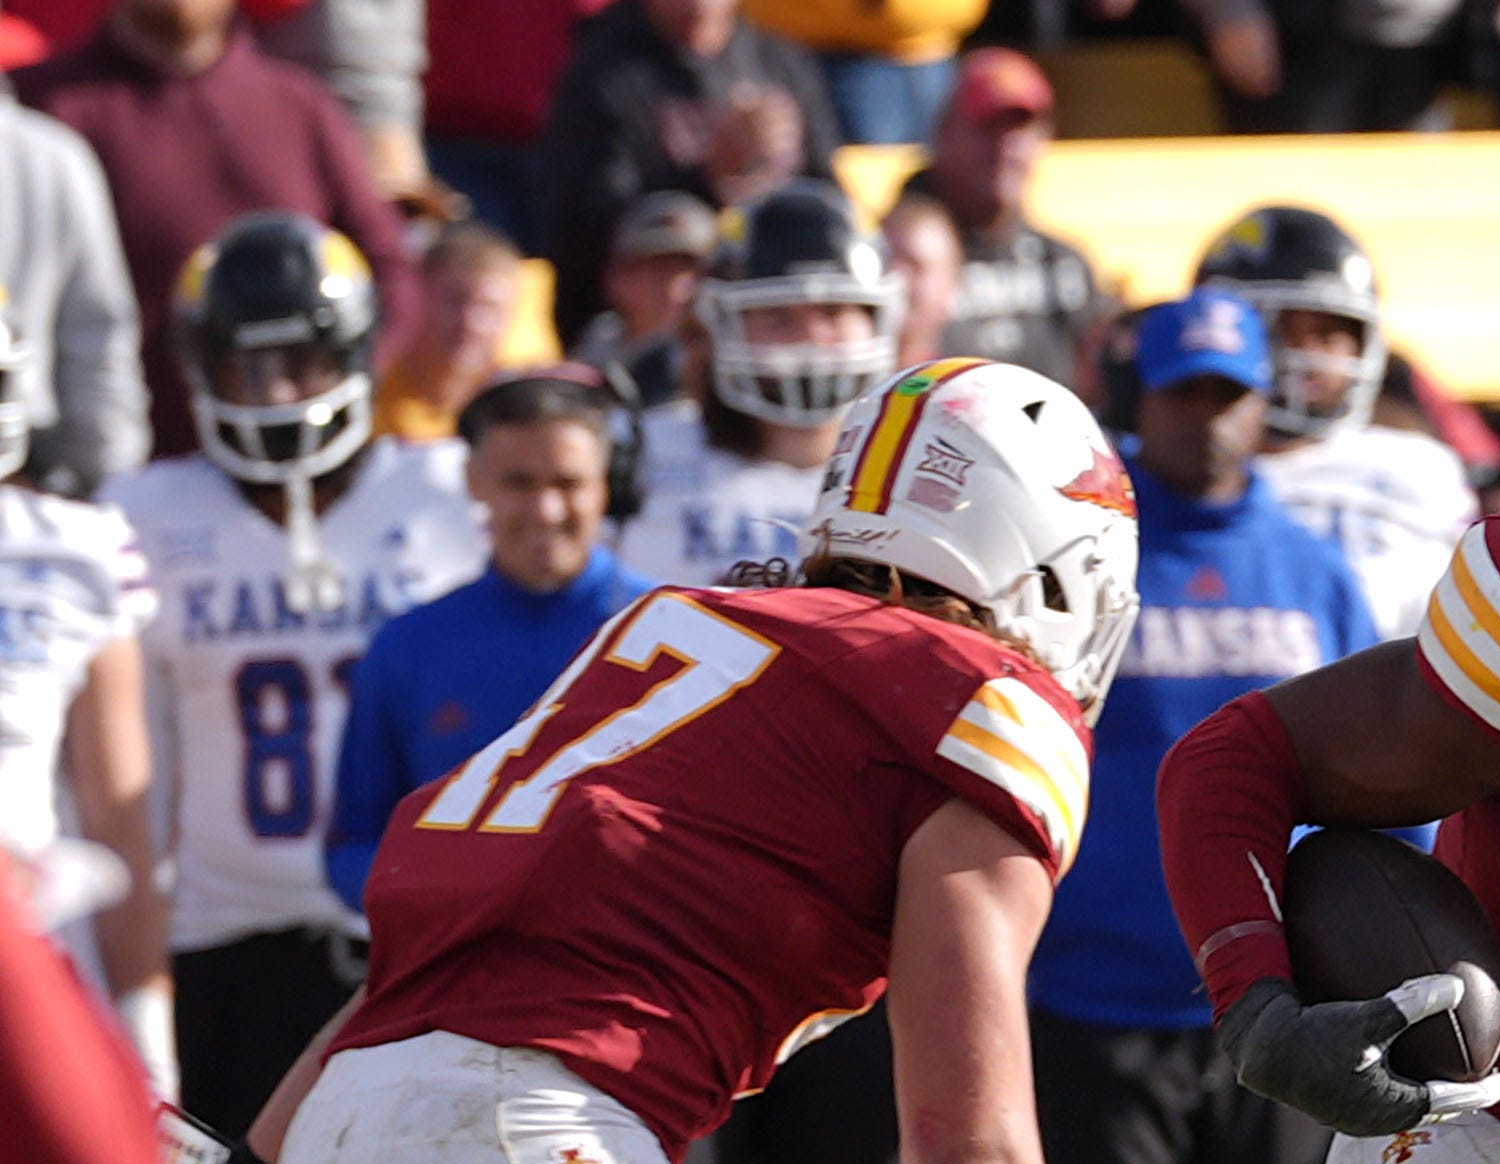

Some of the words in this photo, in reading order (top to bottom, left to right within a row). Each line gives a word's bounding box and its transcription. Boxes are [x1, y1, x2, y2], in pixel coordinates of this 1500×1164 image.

[183, 572, 425, 640] KANA
[1119, 606, 1323, 679] ANSAS
[232, 653, 352, 840] 8
